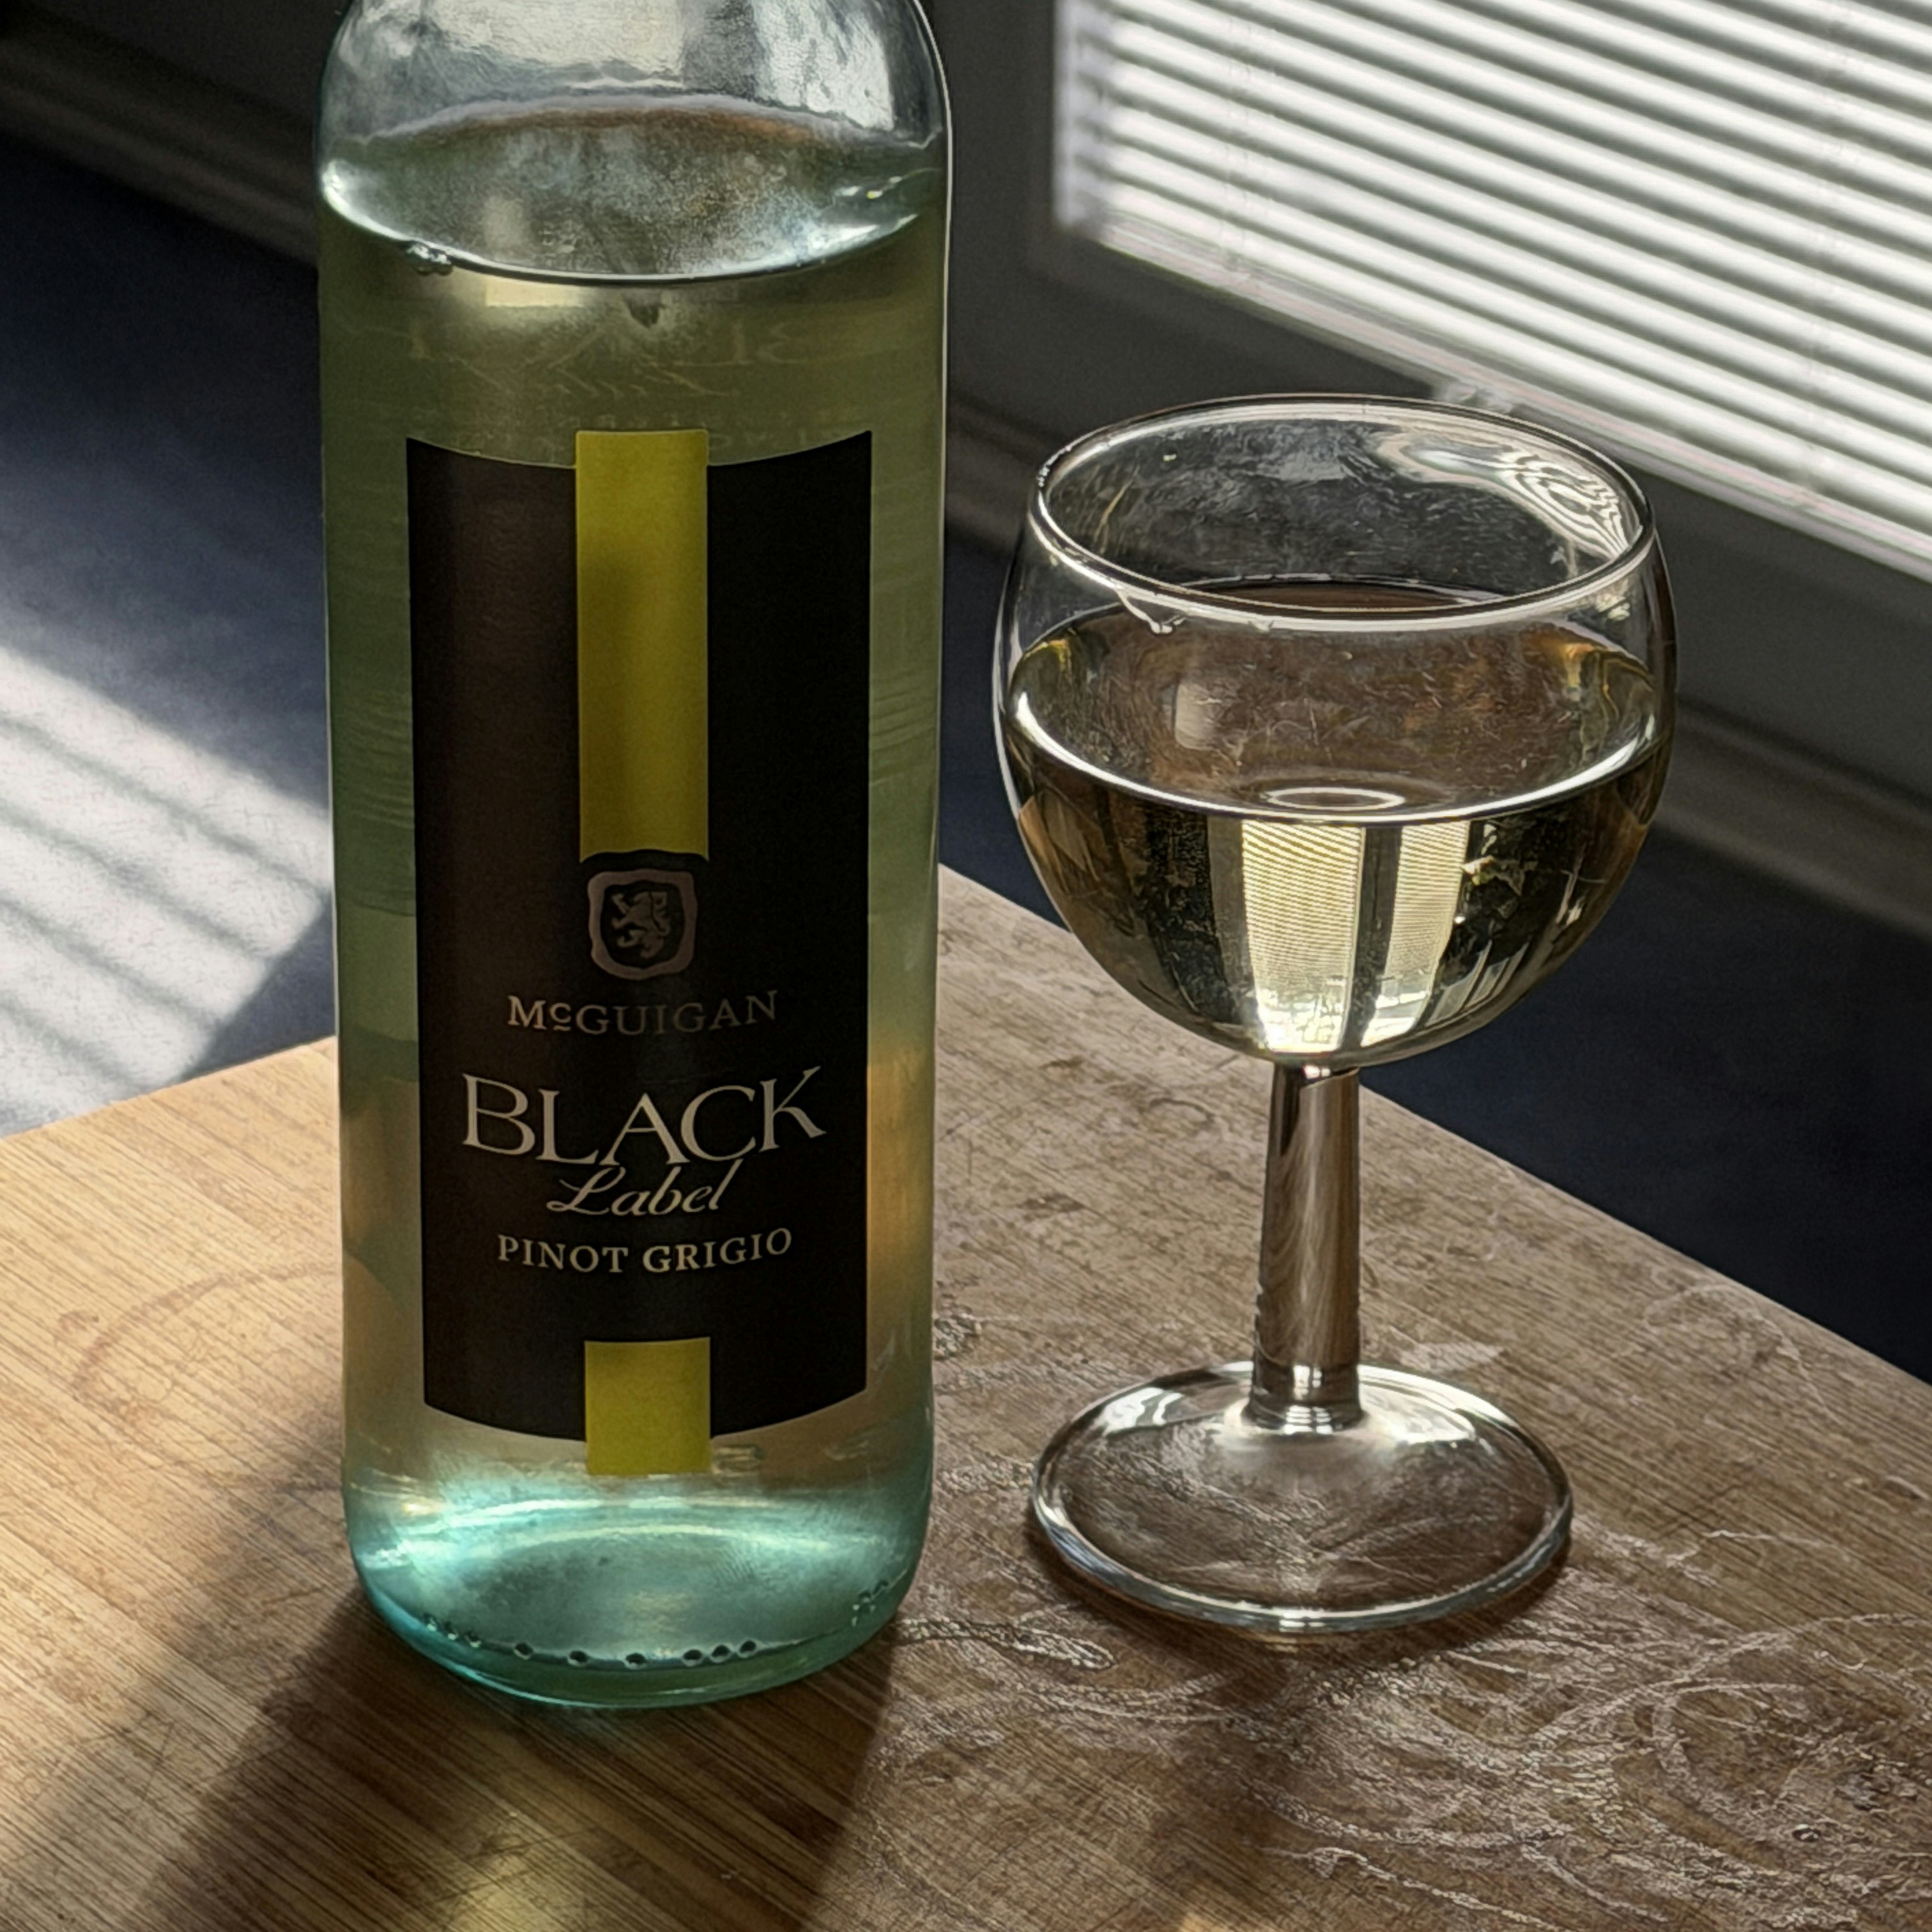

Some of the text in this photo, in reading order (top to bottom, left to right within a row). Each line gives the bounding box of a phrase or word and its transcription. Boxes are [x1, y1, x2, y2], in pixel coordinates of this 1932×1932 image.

[508, 990, 778, 1036] McGUIGAN
[461, 1066, 827, 1167] BLACK
[546, 1158, 744, 1216] Label
[497, 1227, 792, 1273] PINOT GRIGIO
